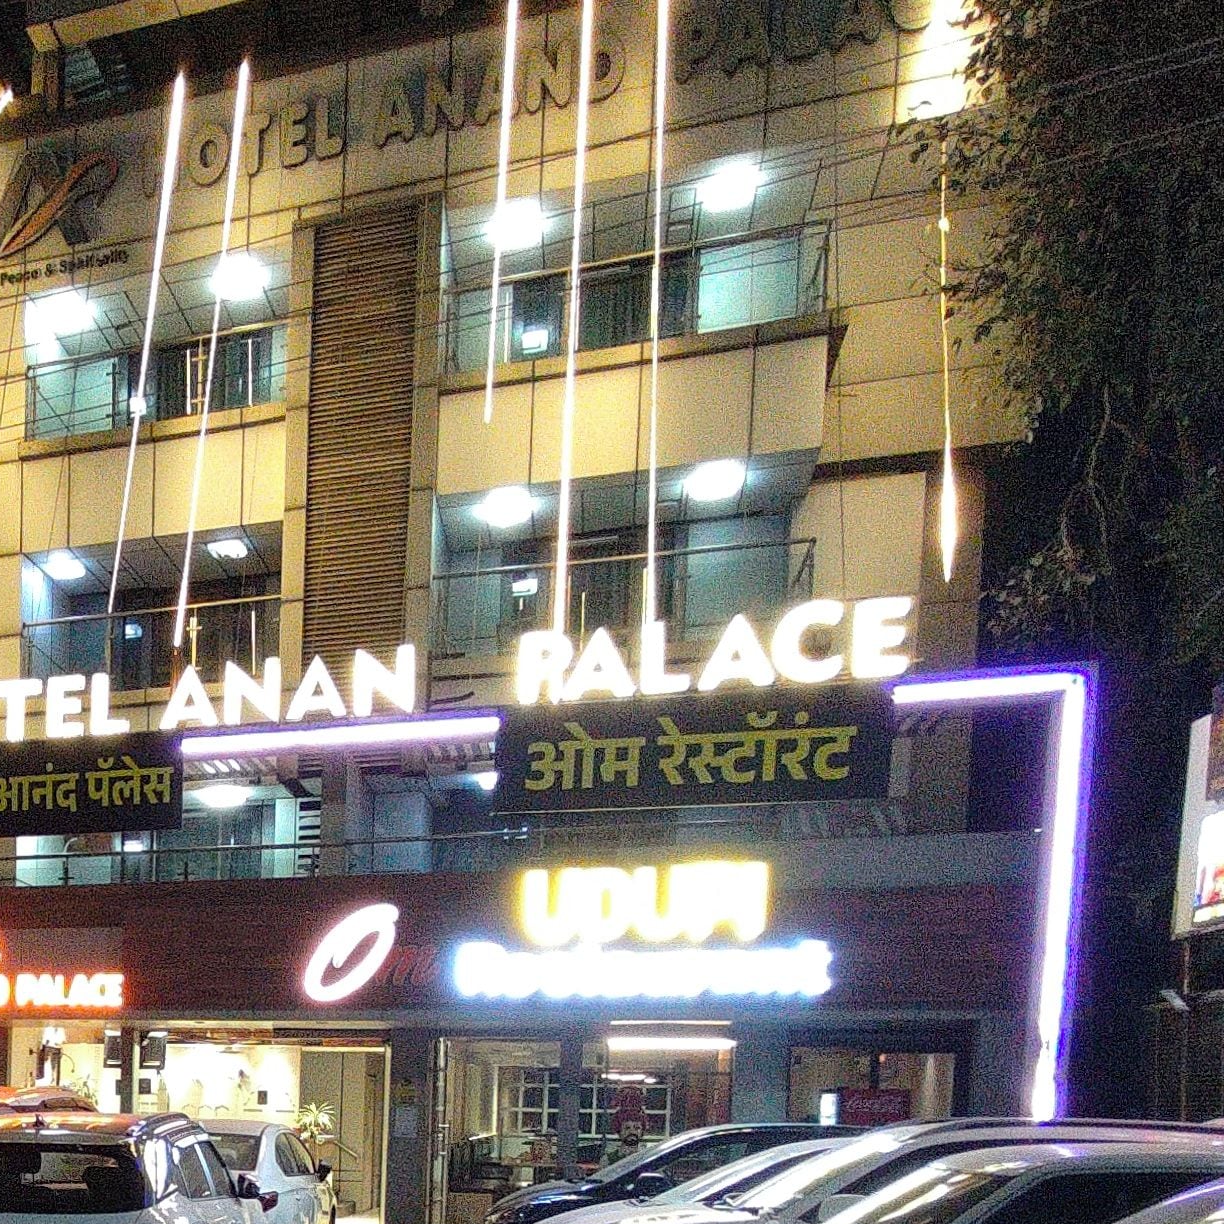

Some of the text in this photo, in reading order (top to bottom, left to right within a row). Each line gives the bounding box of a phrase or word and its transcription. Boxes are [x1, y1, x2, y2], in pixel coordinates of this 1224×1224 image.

[516, 597, 914, 705] PALACE
[84, 755, 174, 807] पॅलेस
[523, 710, 858, 791] ओम रेस्टॉरंट
[14, 972, 125, 1008] PALACE
